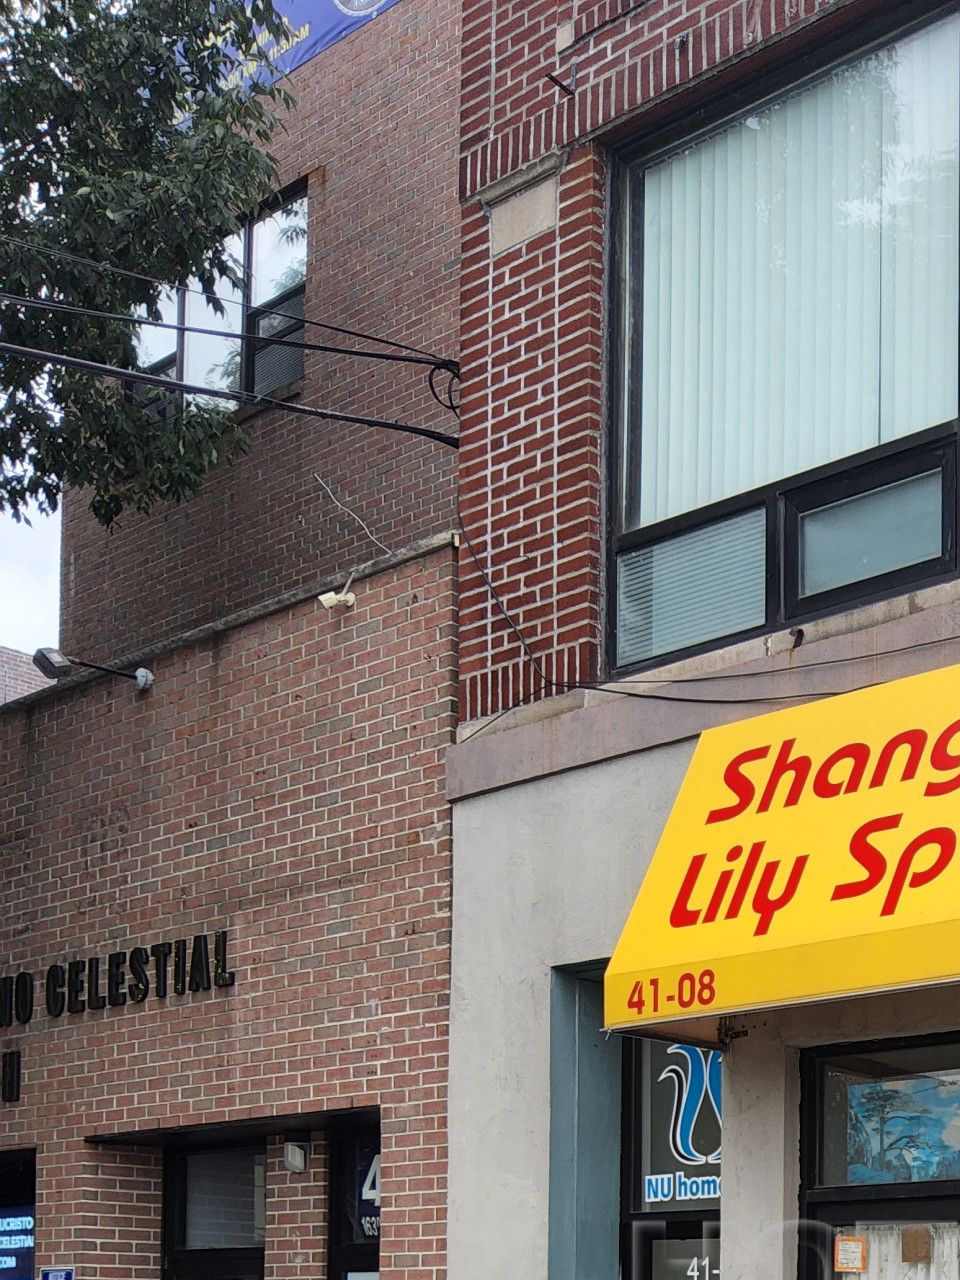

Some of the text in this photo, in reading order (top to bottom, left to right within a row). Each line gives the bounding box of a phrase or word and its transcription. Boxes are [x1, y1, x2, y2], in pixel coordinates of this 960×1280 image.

[669, 841, 810, 937] Lily
[46, 930, 236, 1018] CELESTIAL
[627, 968, 716, 1015] 41-08
[645, 1175, 674, 1202] NU
